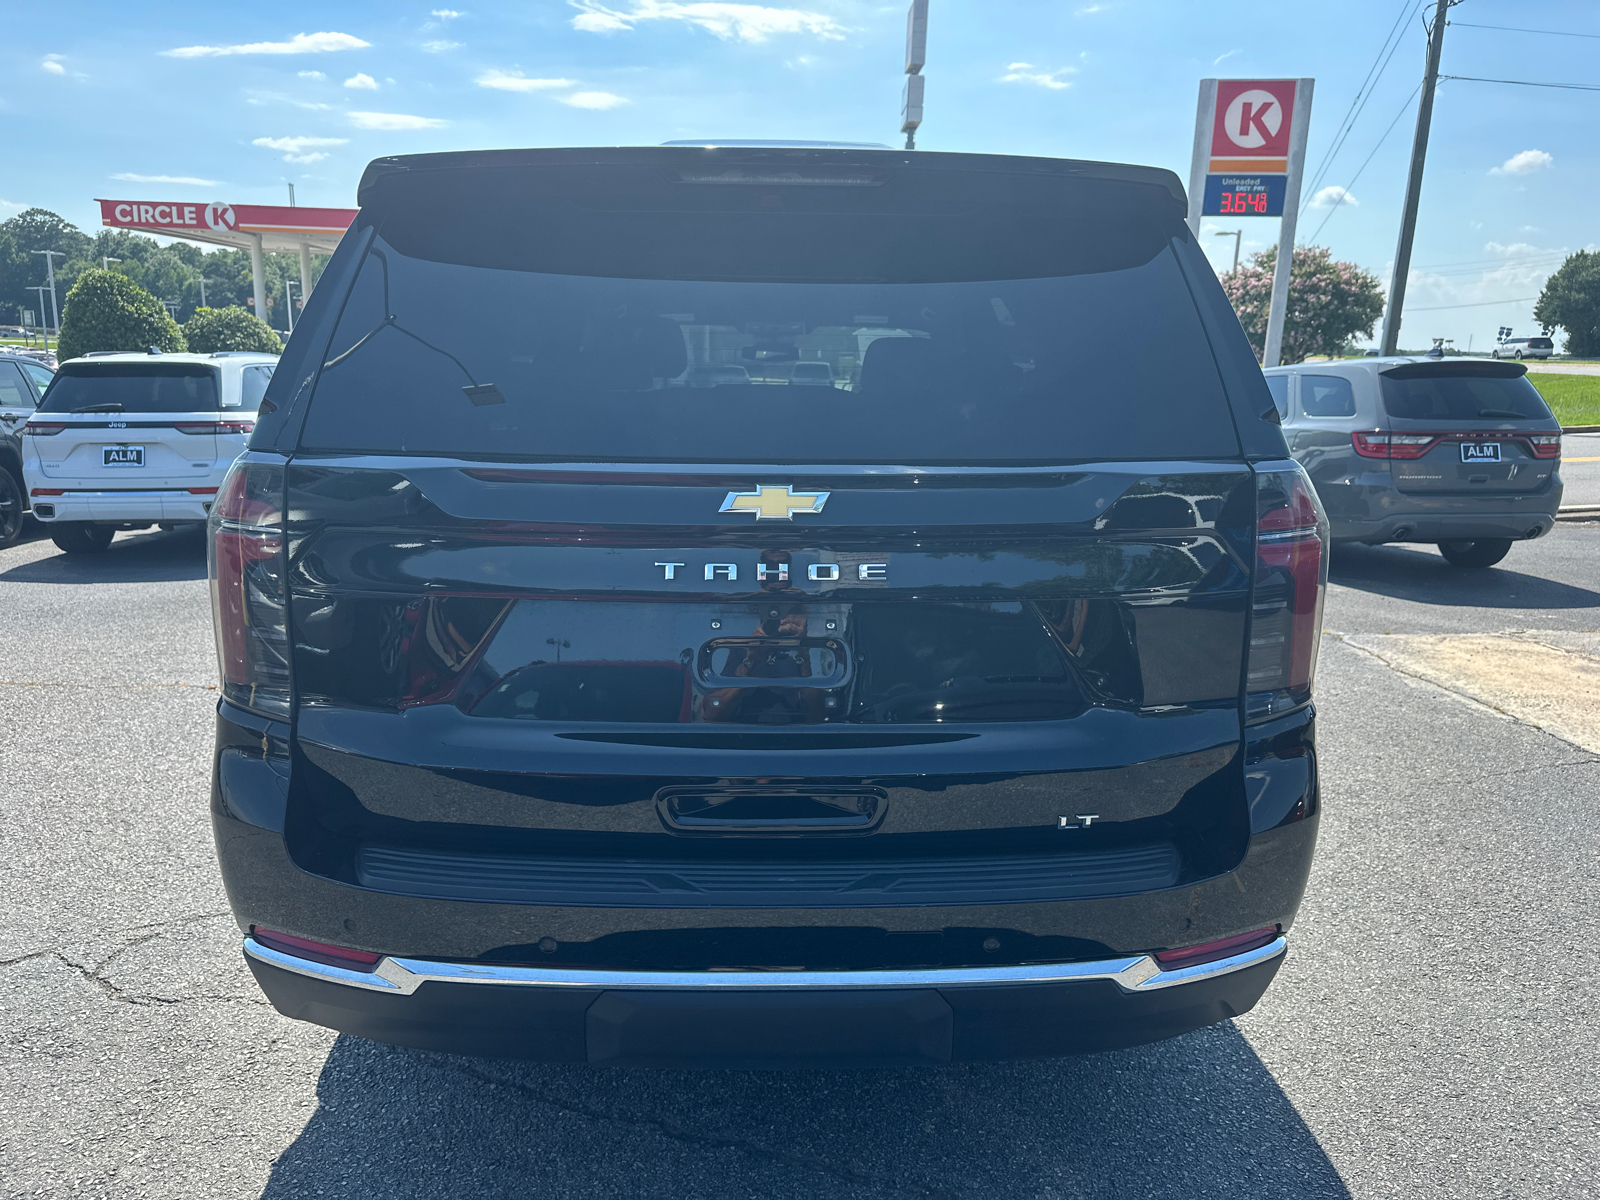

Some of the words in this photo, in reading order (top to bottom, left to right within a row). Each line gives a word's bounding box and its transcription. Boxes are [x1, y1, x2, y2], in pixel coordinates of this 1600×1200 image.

[1239, 102, 1275, 144] K
[115, 204, 197, 224] CIRCLE
[212, 207, 235, 231] K
[110, 450, 137, 461] ALM
[1468, 446, 1493, 457] ALM
[654, 561, 888, 581] TAHOE
[1058, 814, 1100, 830] LT
